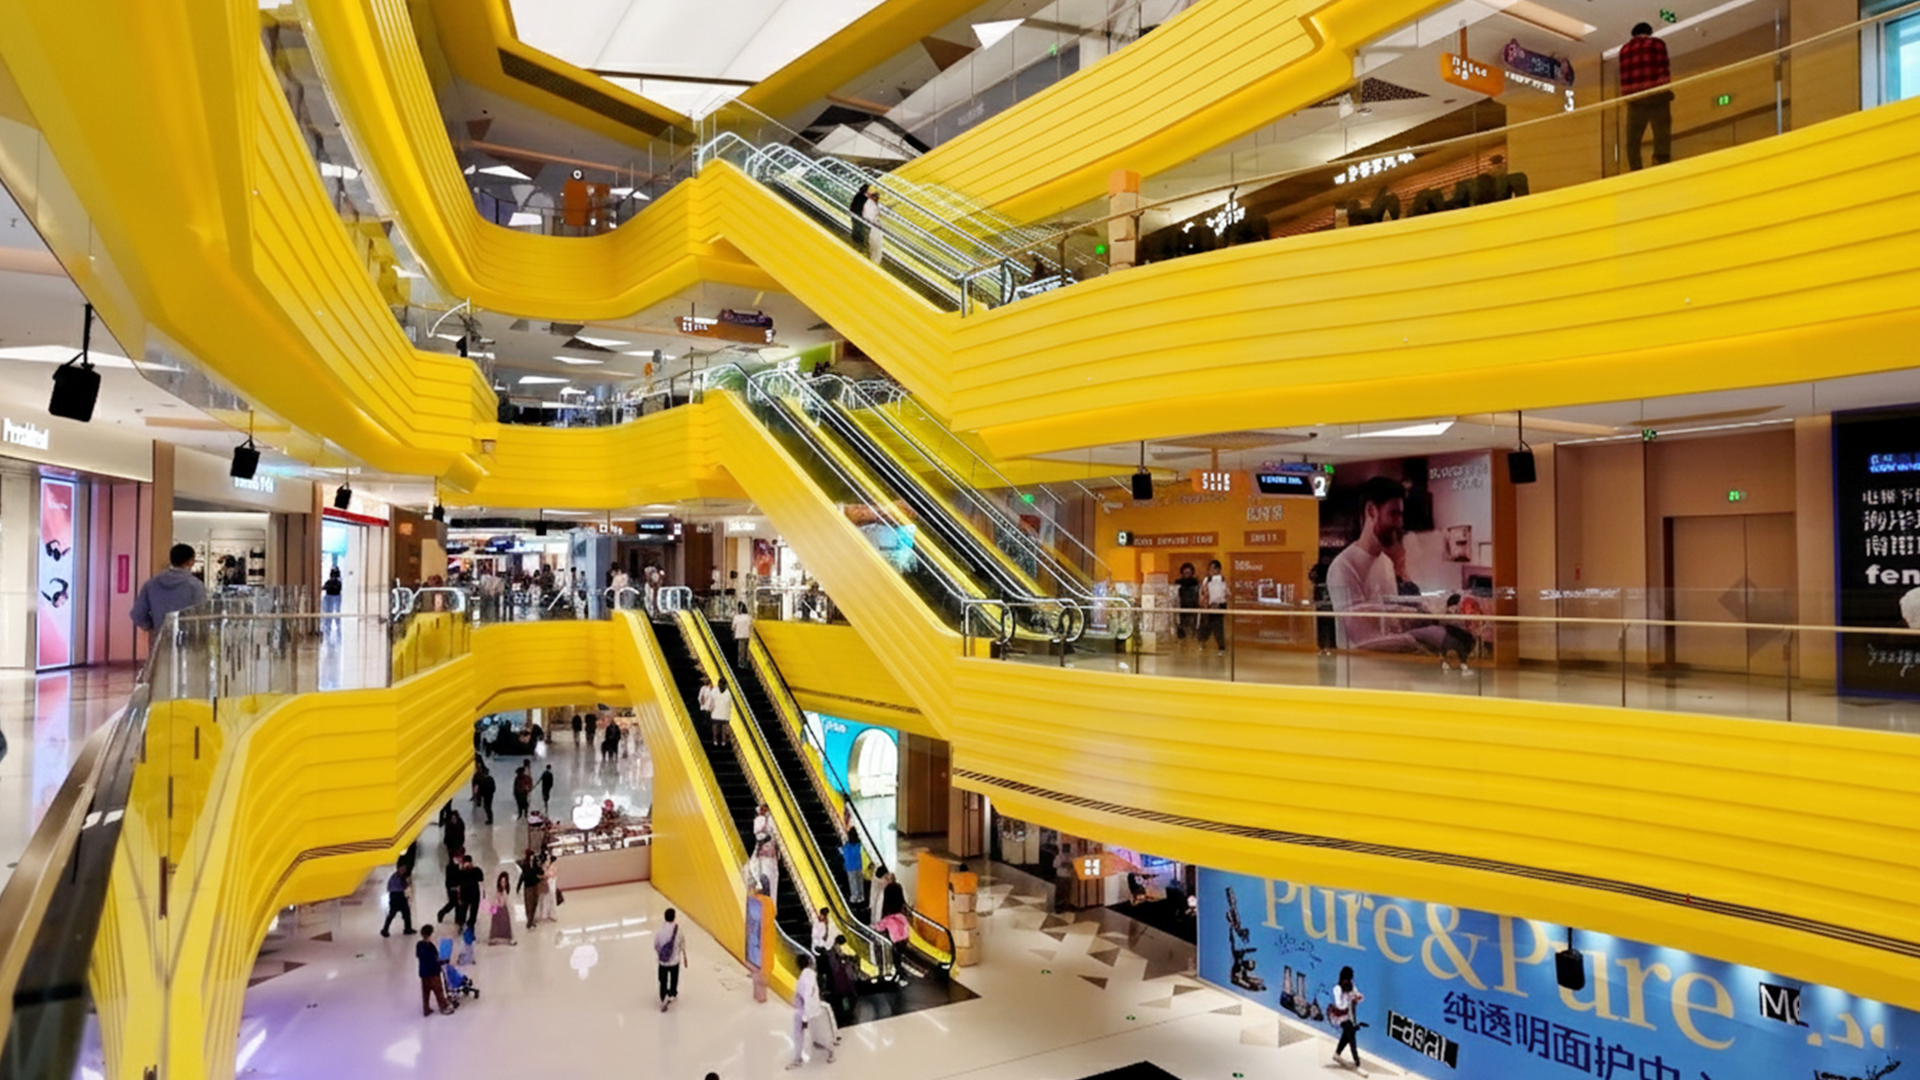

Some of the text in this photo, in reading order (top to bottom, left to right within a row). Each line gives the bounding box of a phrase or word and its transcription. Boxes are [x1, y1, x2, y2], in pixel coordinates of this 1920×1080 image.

[1314, 476, 1326, 497] 2
[1443, 991, 1709, 1080] 纯透明面护中
